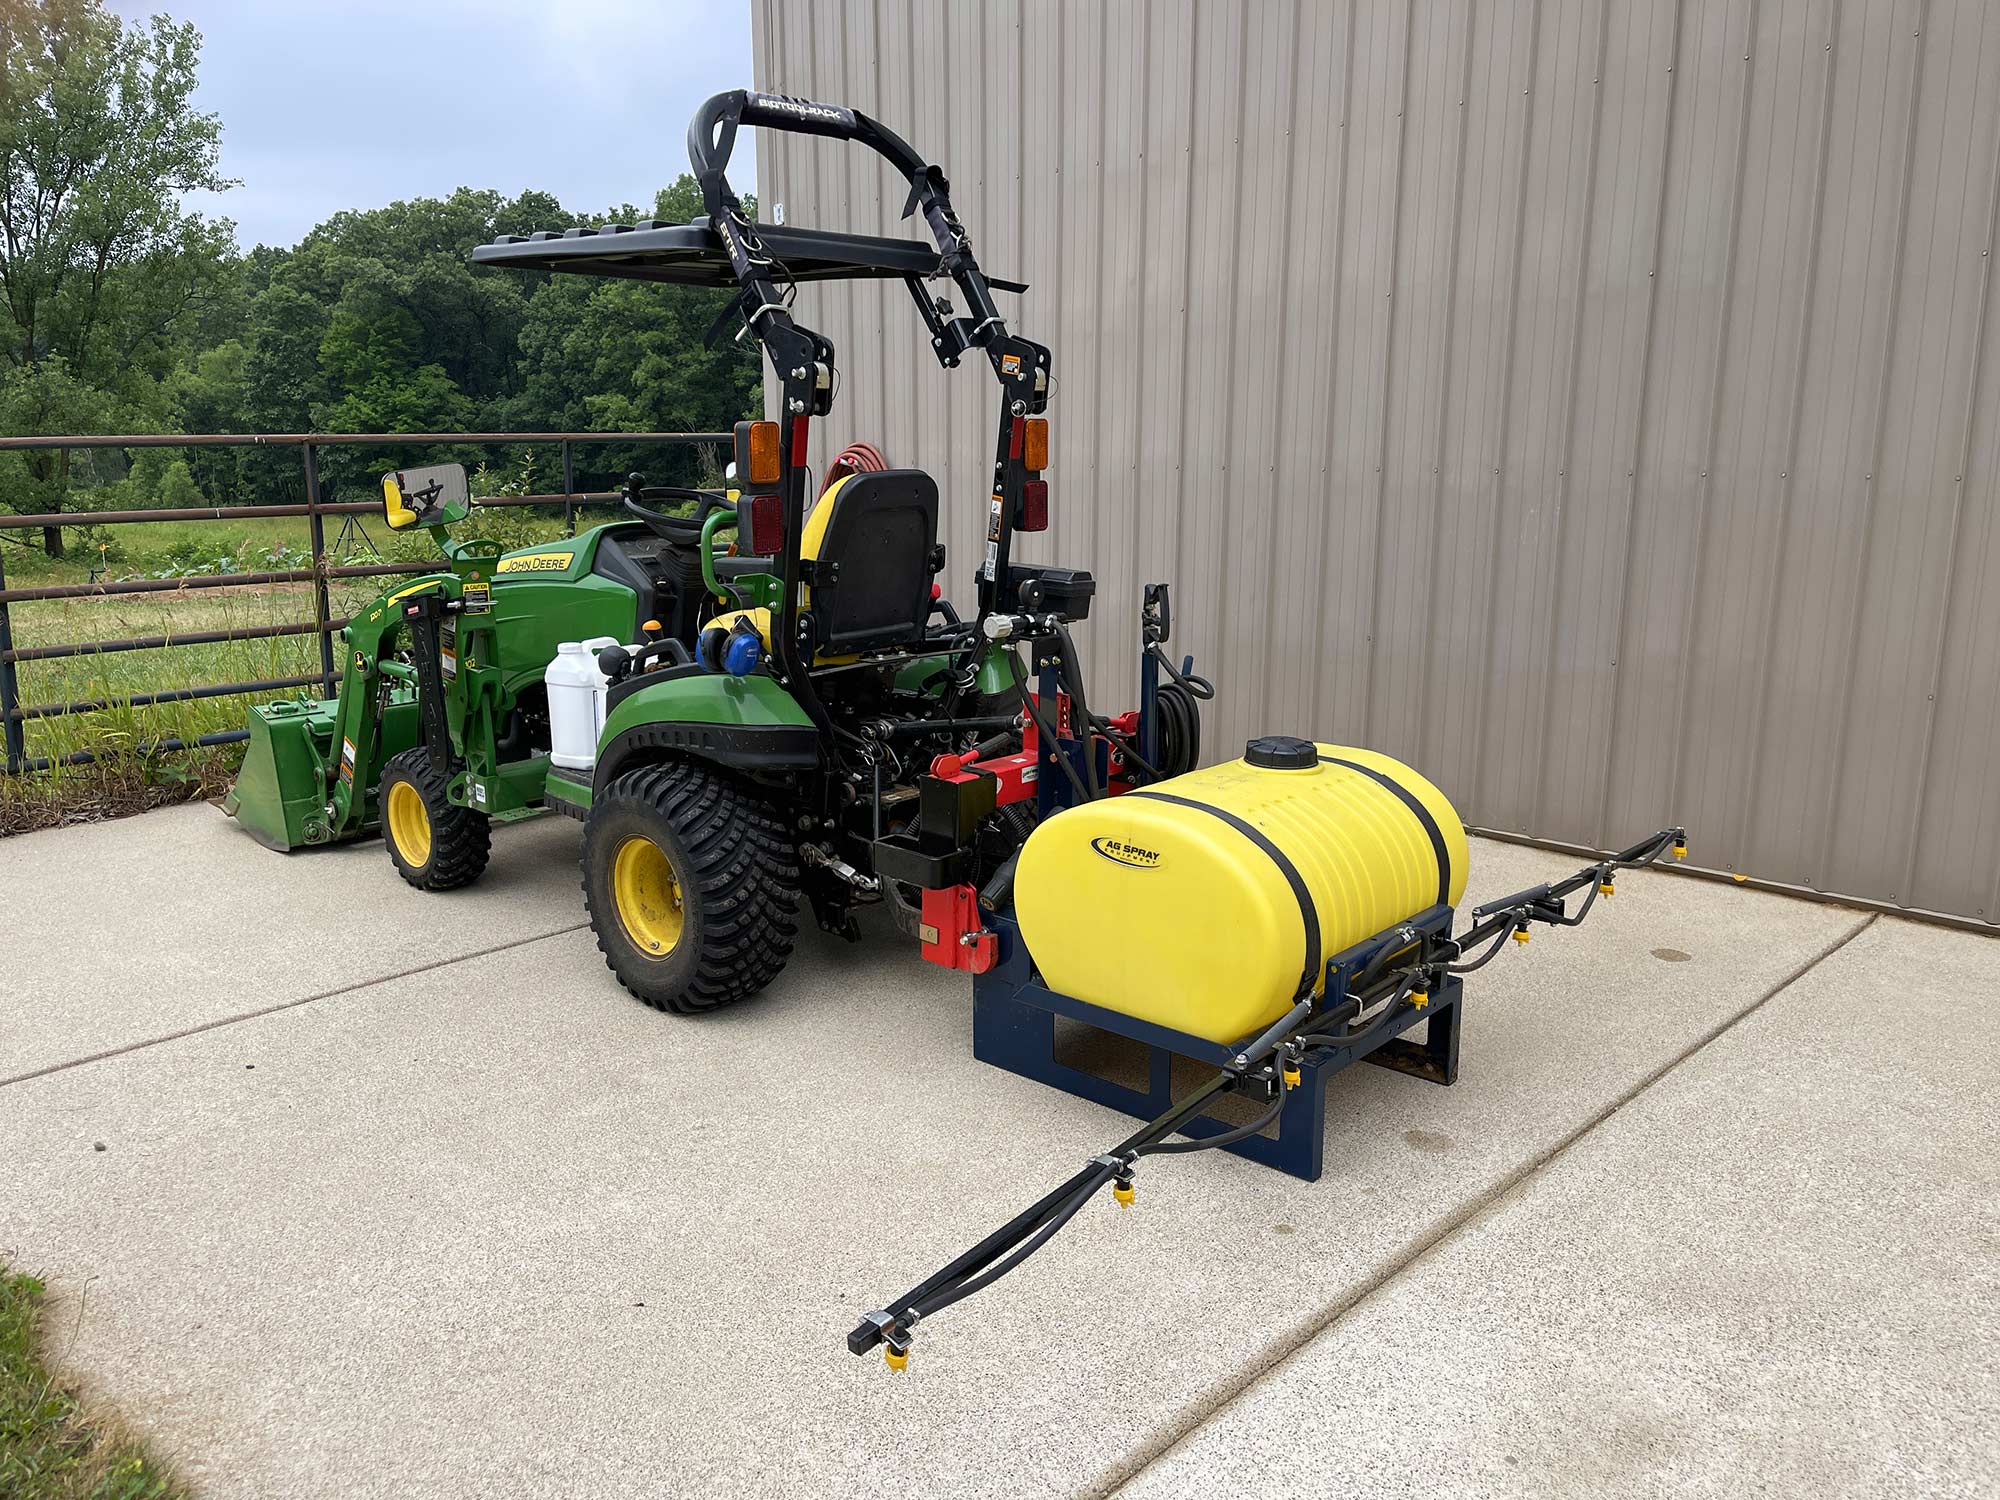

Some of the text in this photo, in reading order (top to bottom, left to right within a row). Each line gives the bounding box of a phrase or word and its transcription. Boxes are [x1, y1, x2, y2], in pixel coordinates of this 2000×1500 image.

[505, 558, 566, 571] JOHN DEERE
[1104, 847, 1156, 865] EQUIPMENT
[1106, 840, 1160, 861] AG SPRAY
